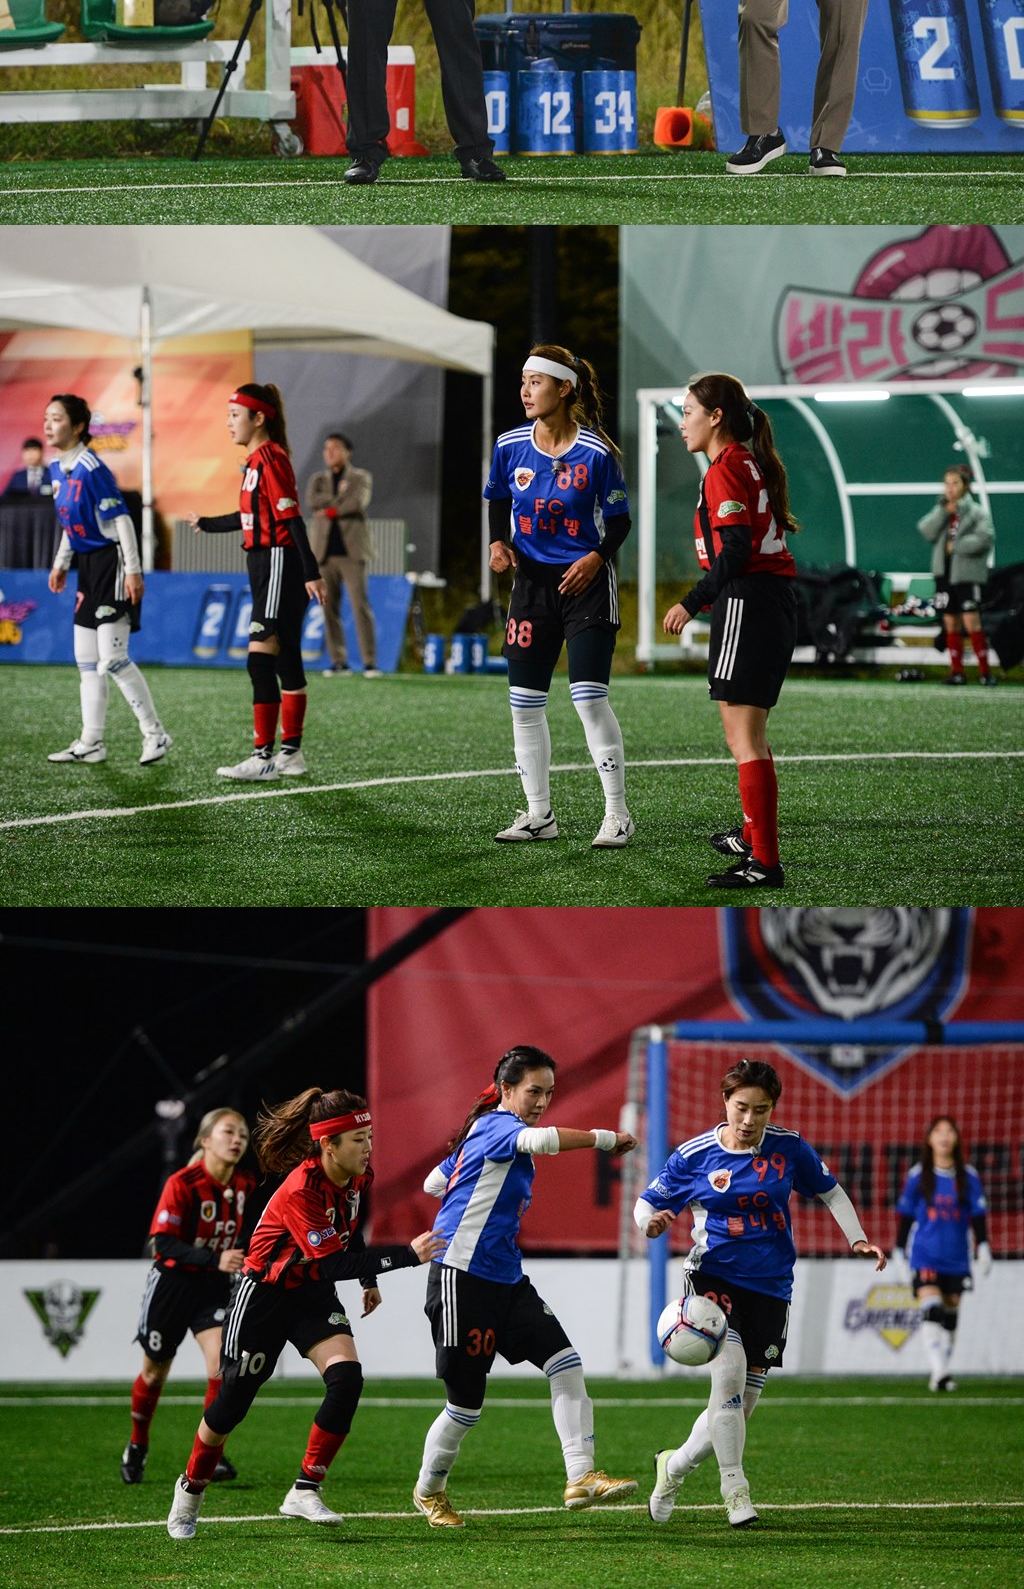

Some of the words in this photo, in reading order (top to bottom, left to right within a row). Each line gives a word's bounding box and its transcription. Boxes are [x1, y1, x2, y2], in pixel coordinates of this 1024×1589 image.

[913, 16, 956, 81] 2
[539, 91, 572, 135] 12
[594, 90, 634, 134] 34
[557, 462, 589, 491] 88
[534, 498, 564, 515] FC
[507, 617, 533, 649] 88
[752, 1152, 786, 1182] 99
[737, 1191, 769, 1210] FC
[214, 1220, 237, 1237] FC
[149, 1330, 163, 1352] 8
[466, 1328, 496, 1357] 30
[239, 1349, 266, 1377] 10
